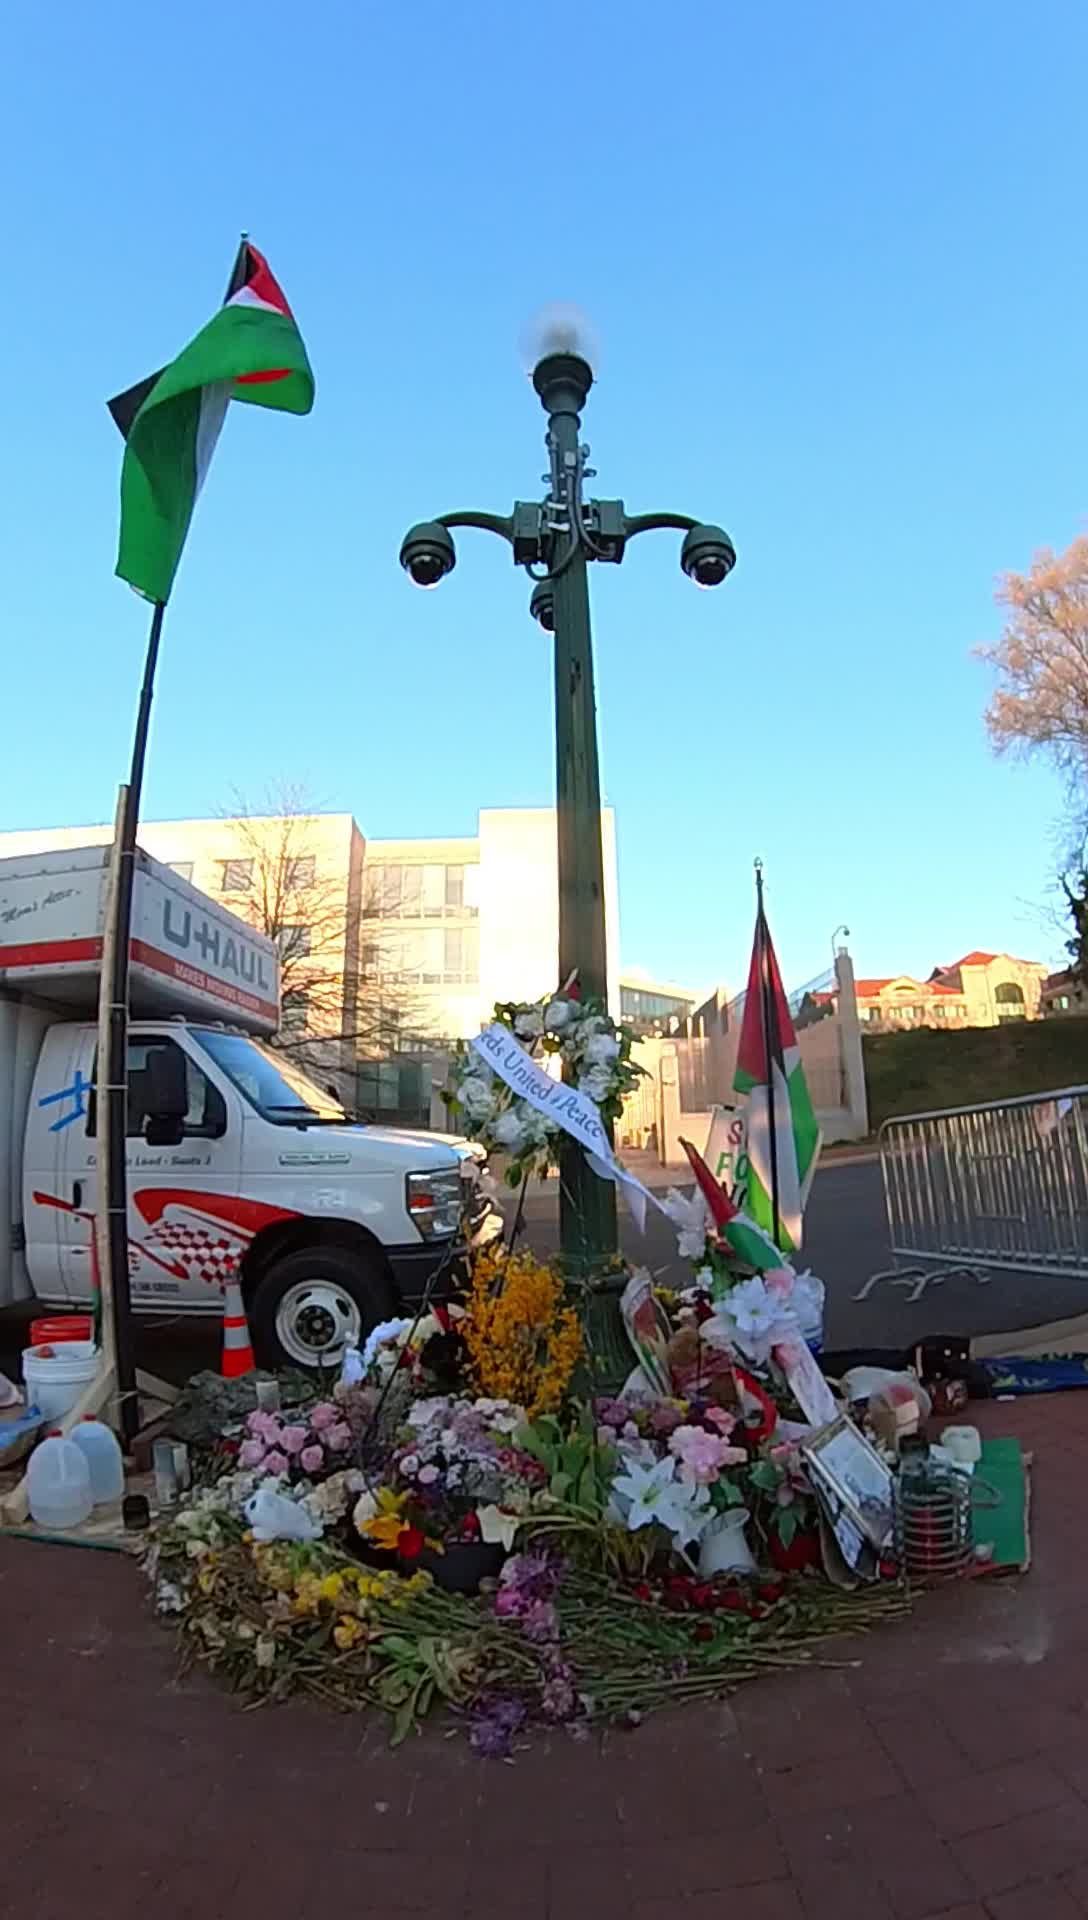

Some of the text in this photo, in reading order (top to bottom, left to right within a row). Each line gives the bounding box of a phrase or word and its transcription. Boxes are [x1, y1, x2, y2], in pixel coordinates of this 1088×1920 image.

[163, 899, 269, 991] U-HAUL
[503, 1050, 555, 1101] United
[715, 1151, 751, 1181] FO
